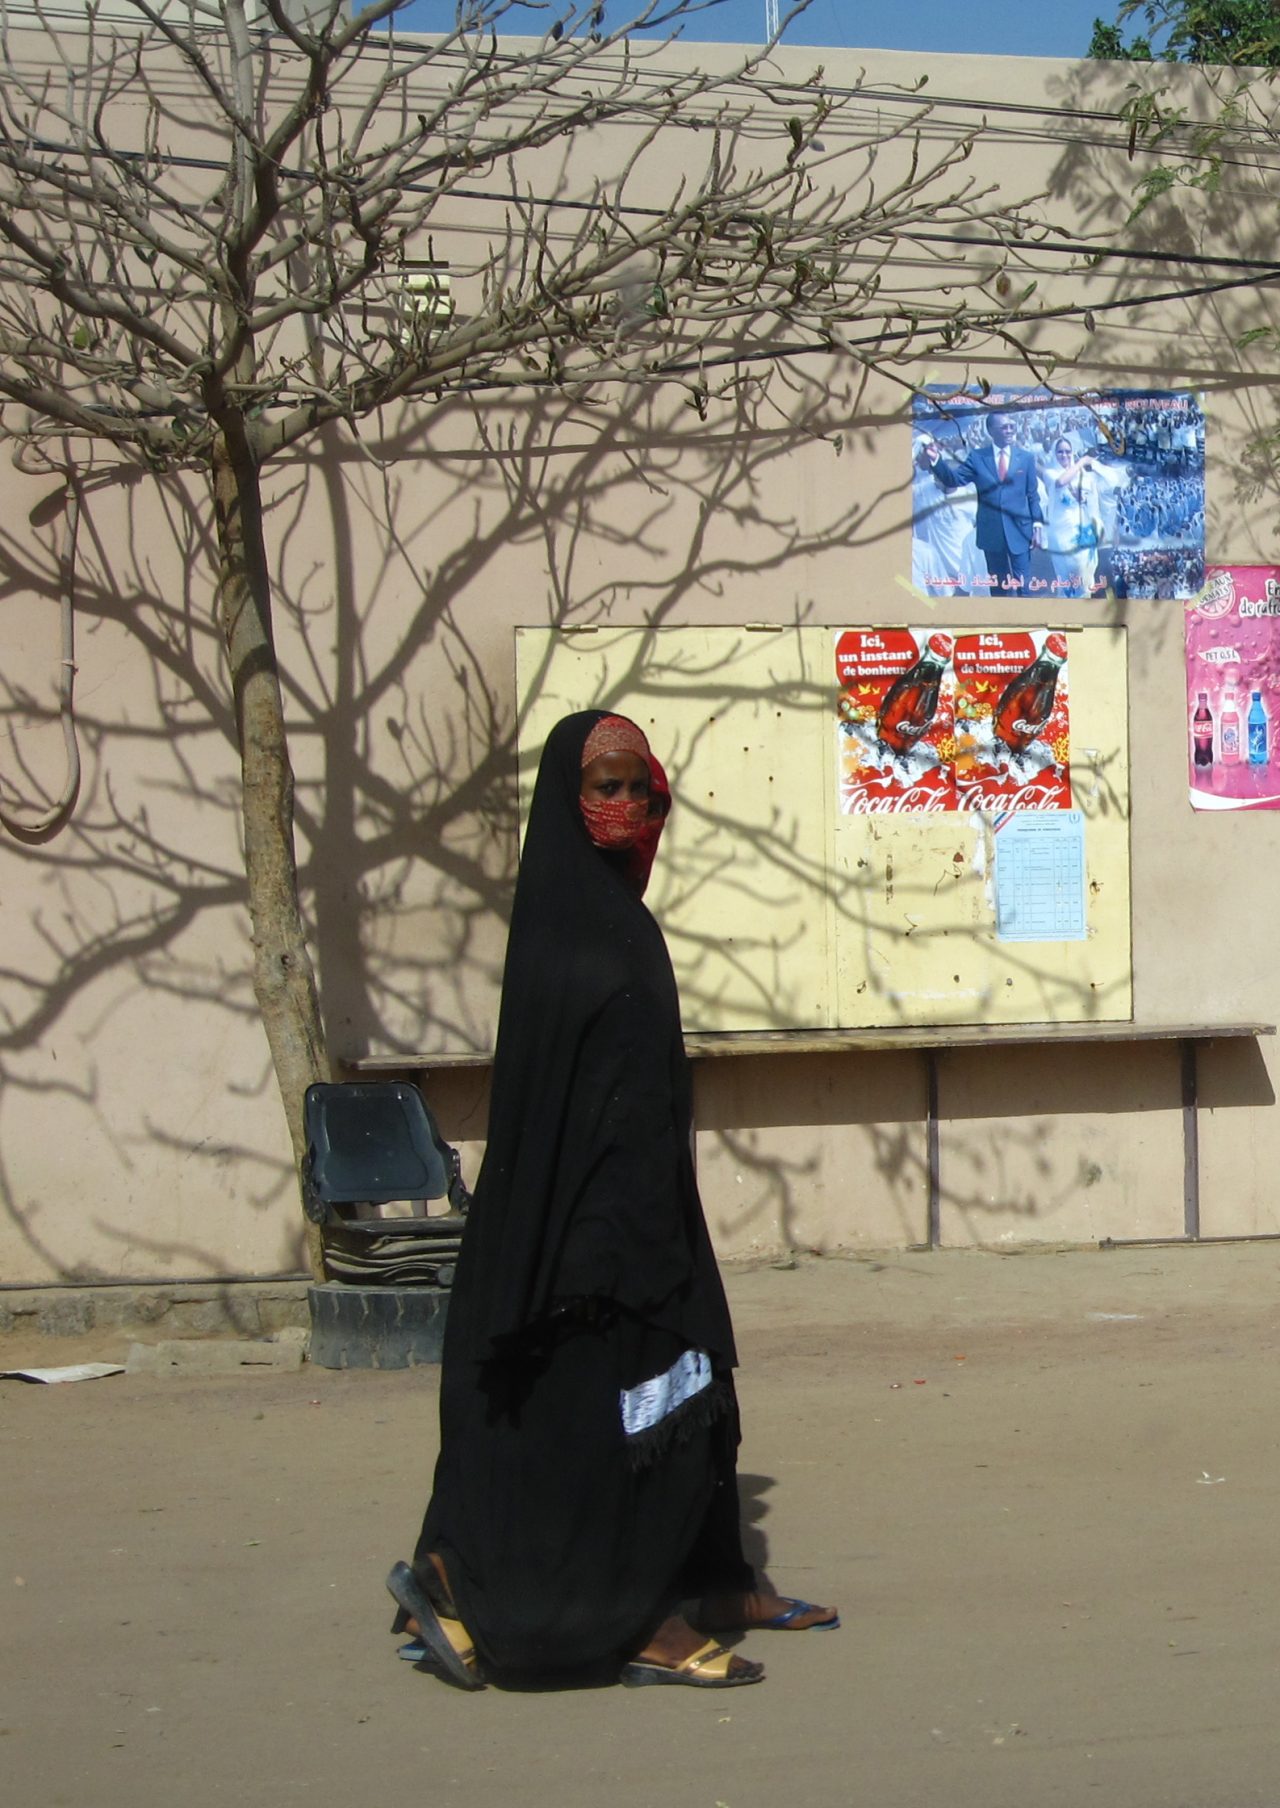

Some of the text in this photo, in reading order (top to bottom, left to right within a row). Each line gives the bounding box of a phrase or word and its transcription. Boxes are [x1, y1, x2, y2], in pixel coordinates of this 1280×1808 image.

[1240, 598, 1253, 614] de
[860, 633, 886, 650] Ici,
[978, 633, 1004, 648] Ici,
[838, 650, 913, 663] un instant
[956, 648, 1031, 660] un instant
[843, 664, 907, 676] de bonheur
[960, 663, 1024, 674] de bonheur
[842, 786, 950, 813] Coca-Cola
[958, 785, 1065, 811] Coca-Cola
